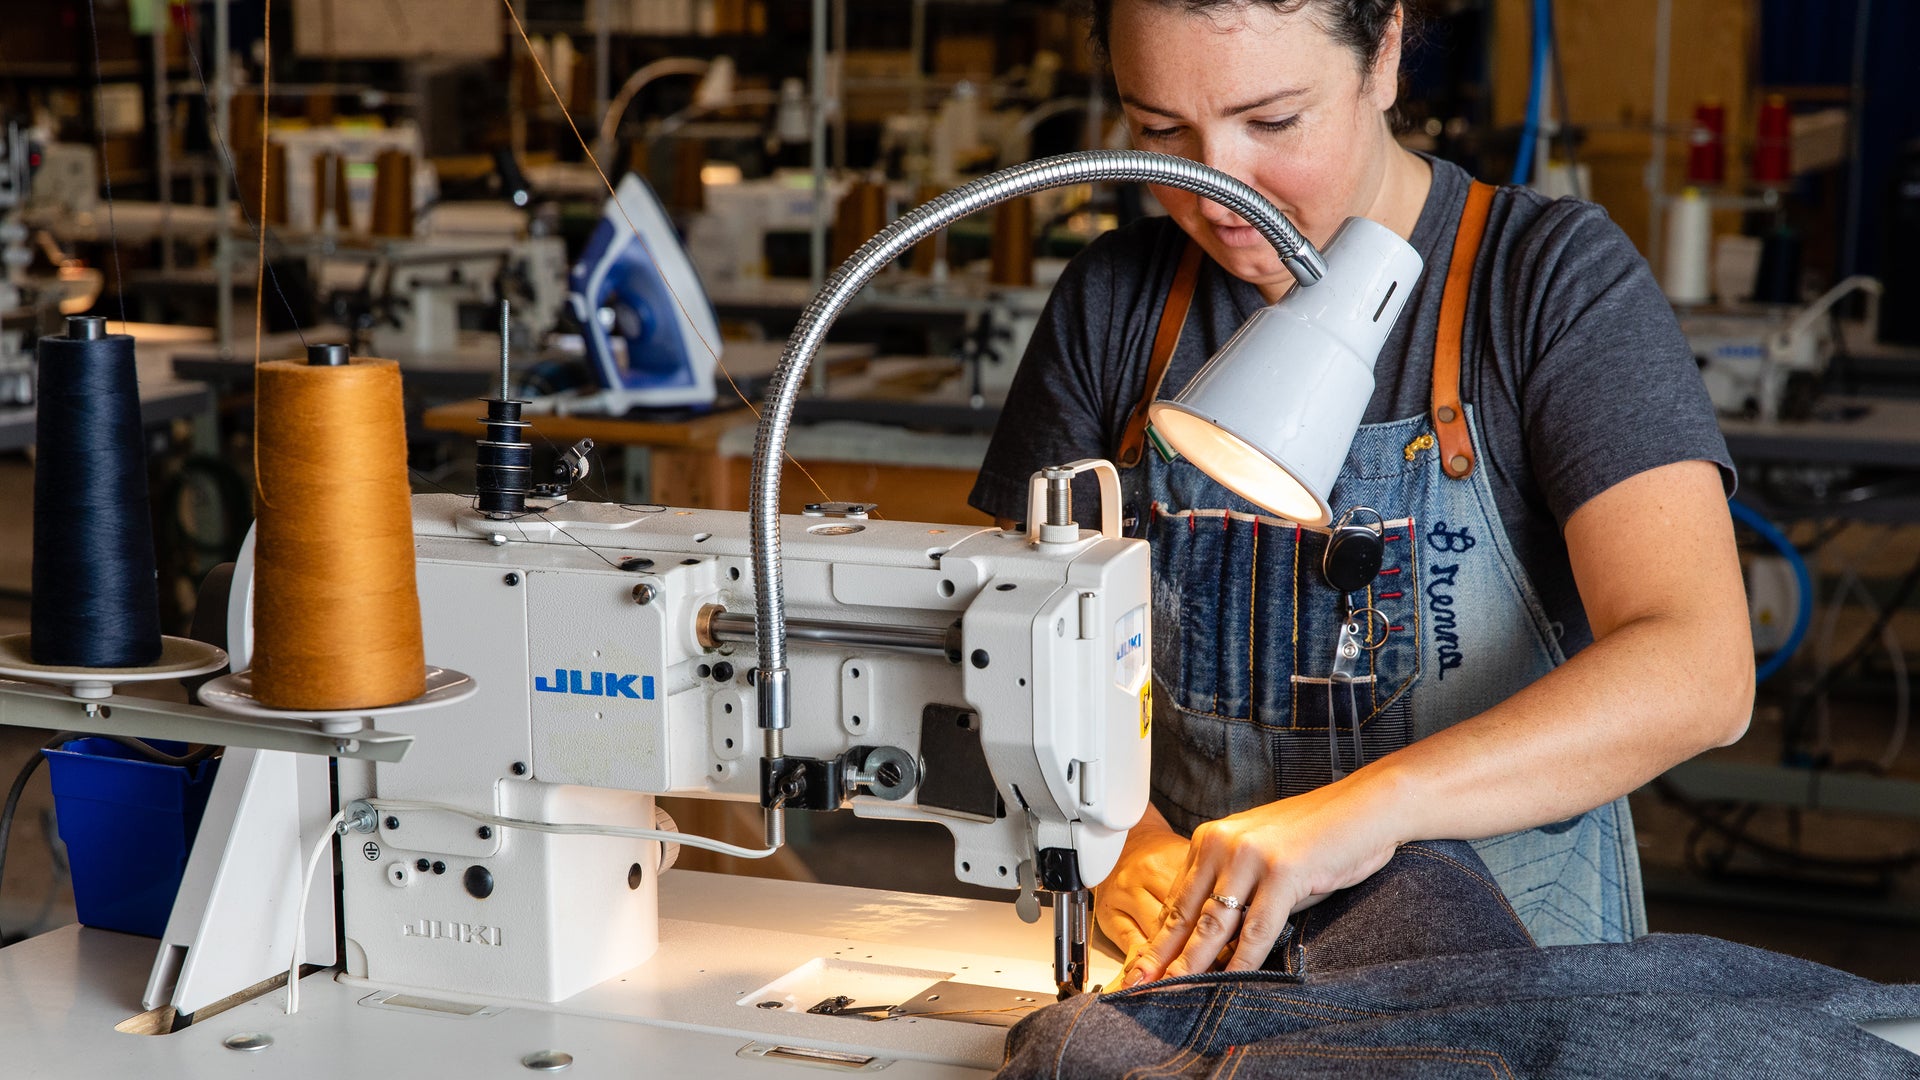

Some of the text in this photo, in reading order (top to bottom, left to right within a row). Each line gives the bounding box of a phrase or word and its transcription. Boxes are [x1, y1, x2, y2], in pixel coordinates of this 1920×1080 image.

[1427, 521, 1476, 681] Brenna
[1116, 633, 1142, 661] JUKI
[535, 668, 655, 700] JUKI
[403, 919, 502, 946] JUKI
